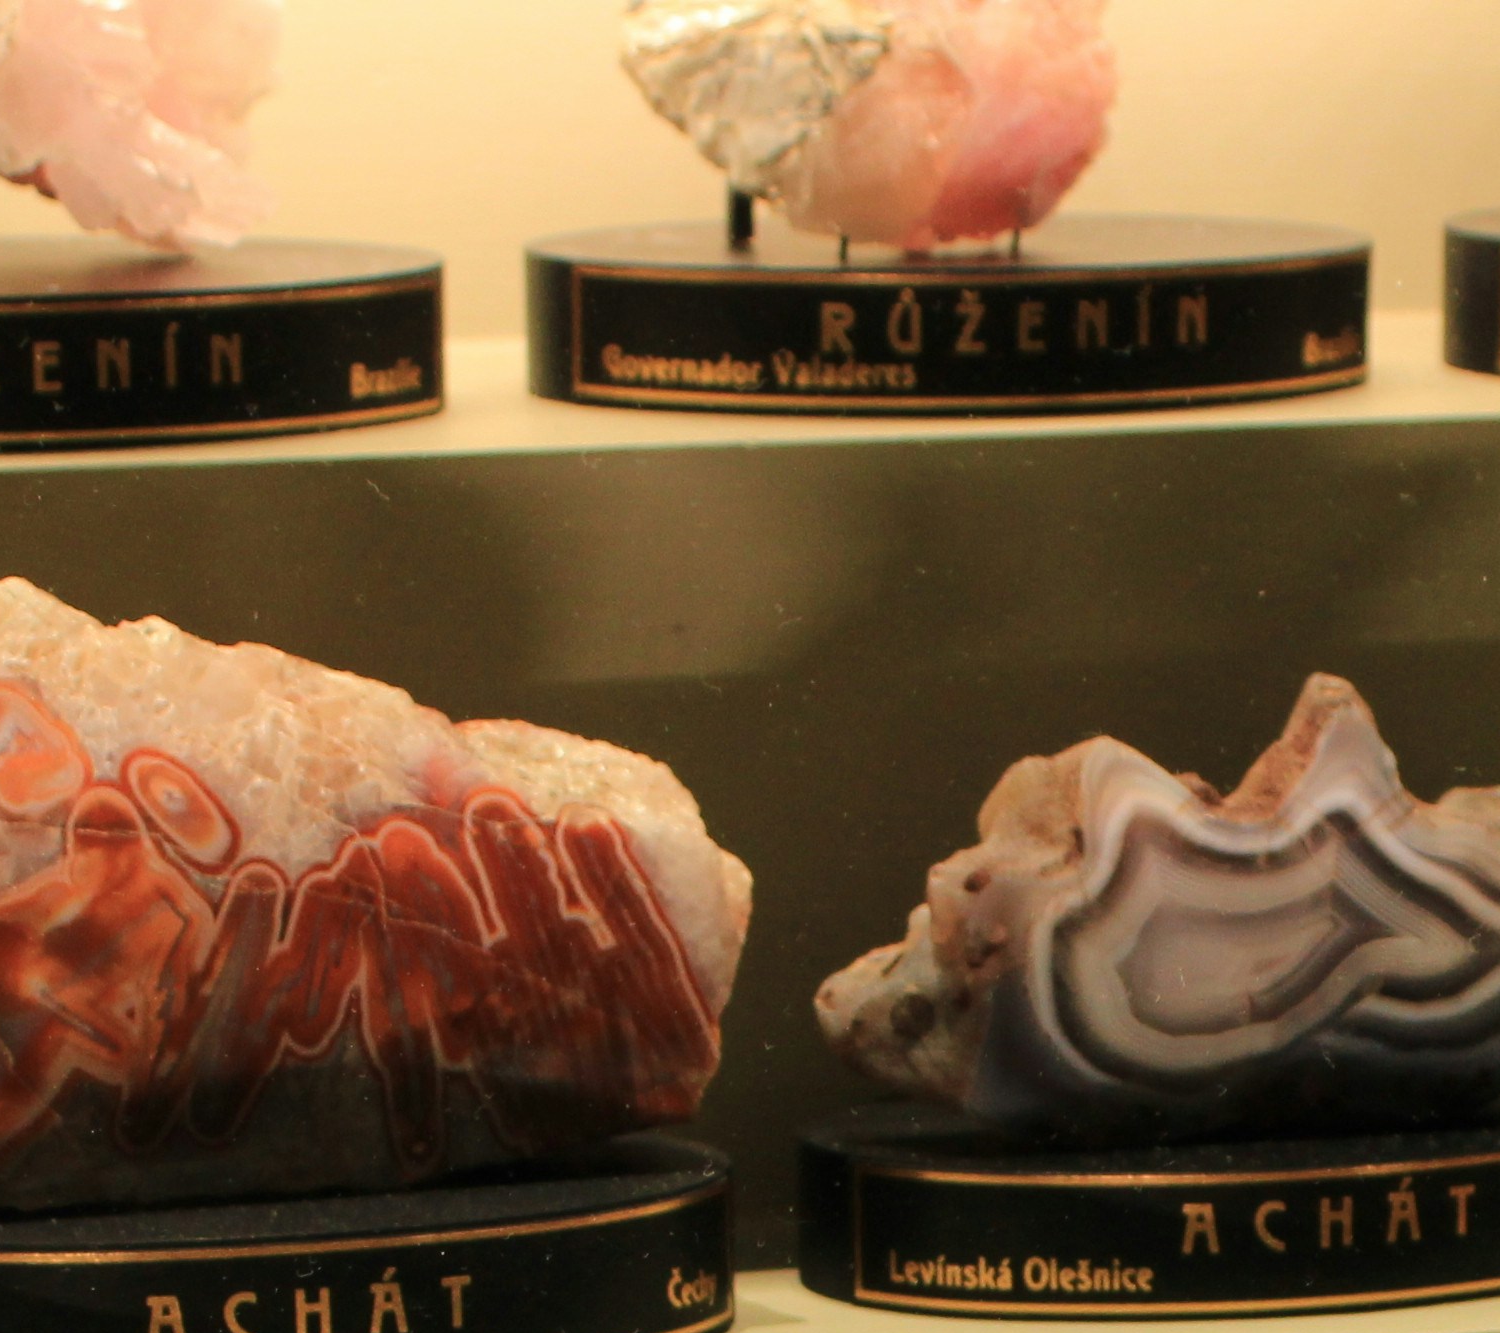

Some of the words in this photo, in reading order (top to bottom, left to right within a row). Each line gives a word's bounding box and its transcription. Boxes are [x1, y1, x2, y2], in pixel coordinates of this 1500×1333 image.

[820, 286, 1208, 354] RŮŽENÍN
[1181, 1178, 1474, 1253] ACHÁT
[890, 1251, 1014, 1291] Levínská
[1023, 1256, 1153, 1292] Olešnice
